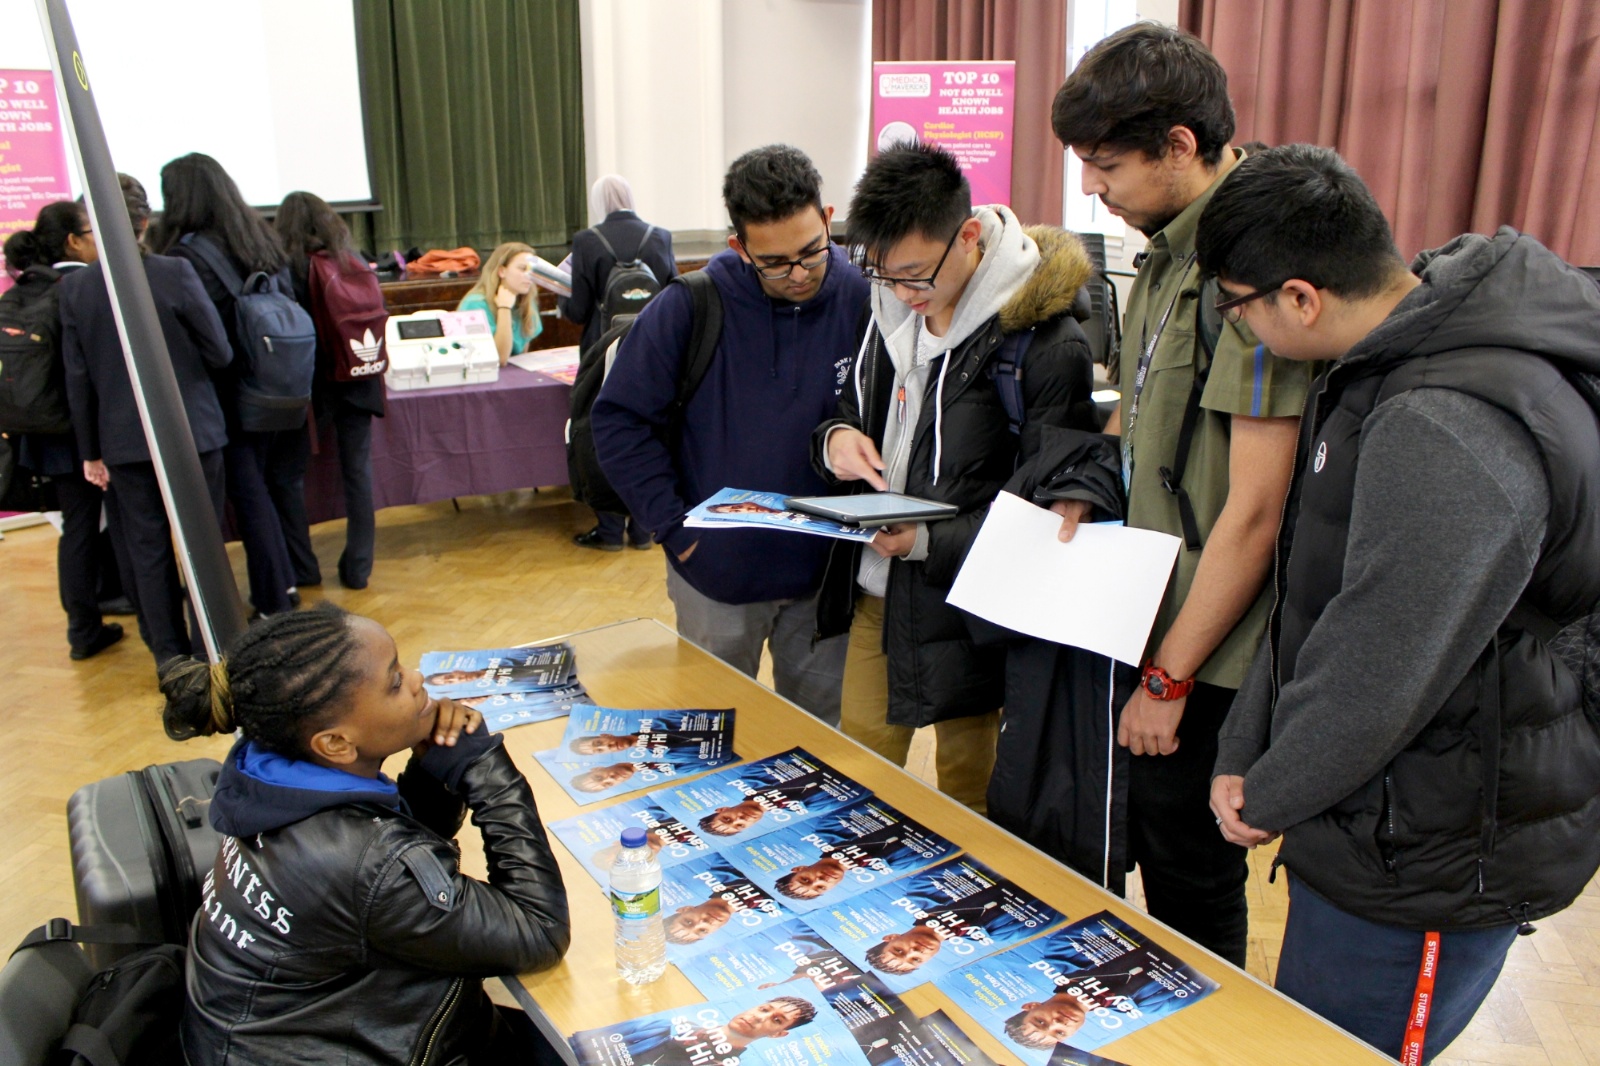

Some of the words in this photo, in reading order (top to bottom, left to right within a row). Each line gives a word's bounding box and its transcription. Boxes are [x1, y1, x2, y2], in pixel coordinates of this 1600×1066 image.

[943, 71, 978, 84] TOP
[981, 73, 1000, 84] 10
[13, 80, 40, 94] 10
[940, 88, 960, 96] NOT
[962, 88, 974, 96] SO
[976, 88, 1003, 96] WELL
[10, 100, 48, 110] WELL
[938, 107, 976, 115] HEALTH
[978, 107, 1004, 115] JOBS
[0, 111, 32, 120] OWN
[18, 122, 52, 132] JOBS
[924, 131, 972, 140] Physiologist
[477, 669, 496, 687] Come
[487, 657, 501, 668] and
[498, 676, 513, 686] say
[638, 718, 652, 732] and
[629, 734, 649, 758] Come
[650, 733, 667, 742] Hi
[653, 744, 668, 758] say
[626, 761, 661, 782] Com
[725, 779, 757, 795] and
[763, 788, 788, 801] Hi
[753, 796, 791, 821] Come
[781, 801, 809, 815] say
[630, 810, 660, 828] and
[666, 821, 690, 835] Hi
[654, 828, 689, 856] Come
[682, 836, 707, 850] say
[799, 834, 834, 852] and
[841, 844, 868, 859] Hi
[831, 852, 874, 881] Come
[862, 859, 893, 874] say
[691, 871, 726, 892] and
[733, 883, 760, 899] Hi
[721, 892, 762, 925] Come
[752, 900, 783, 917] say
[889, 896, 928, 919] and
[862, 921, 877, 932] Open
[936, 910, 966, 927] Hi
[839, 924, 861, 941] London
[925, 919, 974, 953] Come
[959, 927, 994, 945] say
[771, 940, 811, 966] and
[1423, 940, 1436, 978] STUDENT
[819, 955, 850, 975] Hi
[1026, 959, 1069, 985] and
[801, 965, 837, 989] me
[1077, 975, 1110, 995] Hi
[974, 989, 999, 1009] London
[978, 985, 1008, 1006] Autumn
[999, 986, 1016, 1000] Open
[870, 1002, 889, 1018] Book
[1067, 986, 1121, 1027] Come
[1104, 996, 1143, 1018] say
[1415, 993, 1428, 1028] STUDENT
[669, 1015, 697, 1038] say
[684, 1042, 714, 1065] Hi
[696, 1009, 733, 1054] Come
[616, 1041, 635, 1066] access
[889, 1044, 913, 1066] ccess
[1408, 1042, 1419, 1066] STUDE
